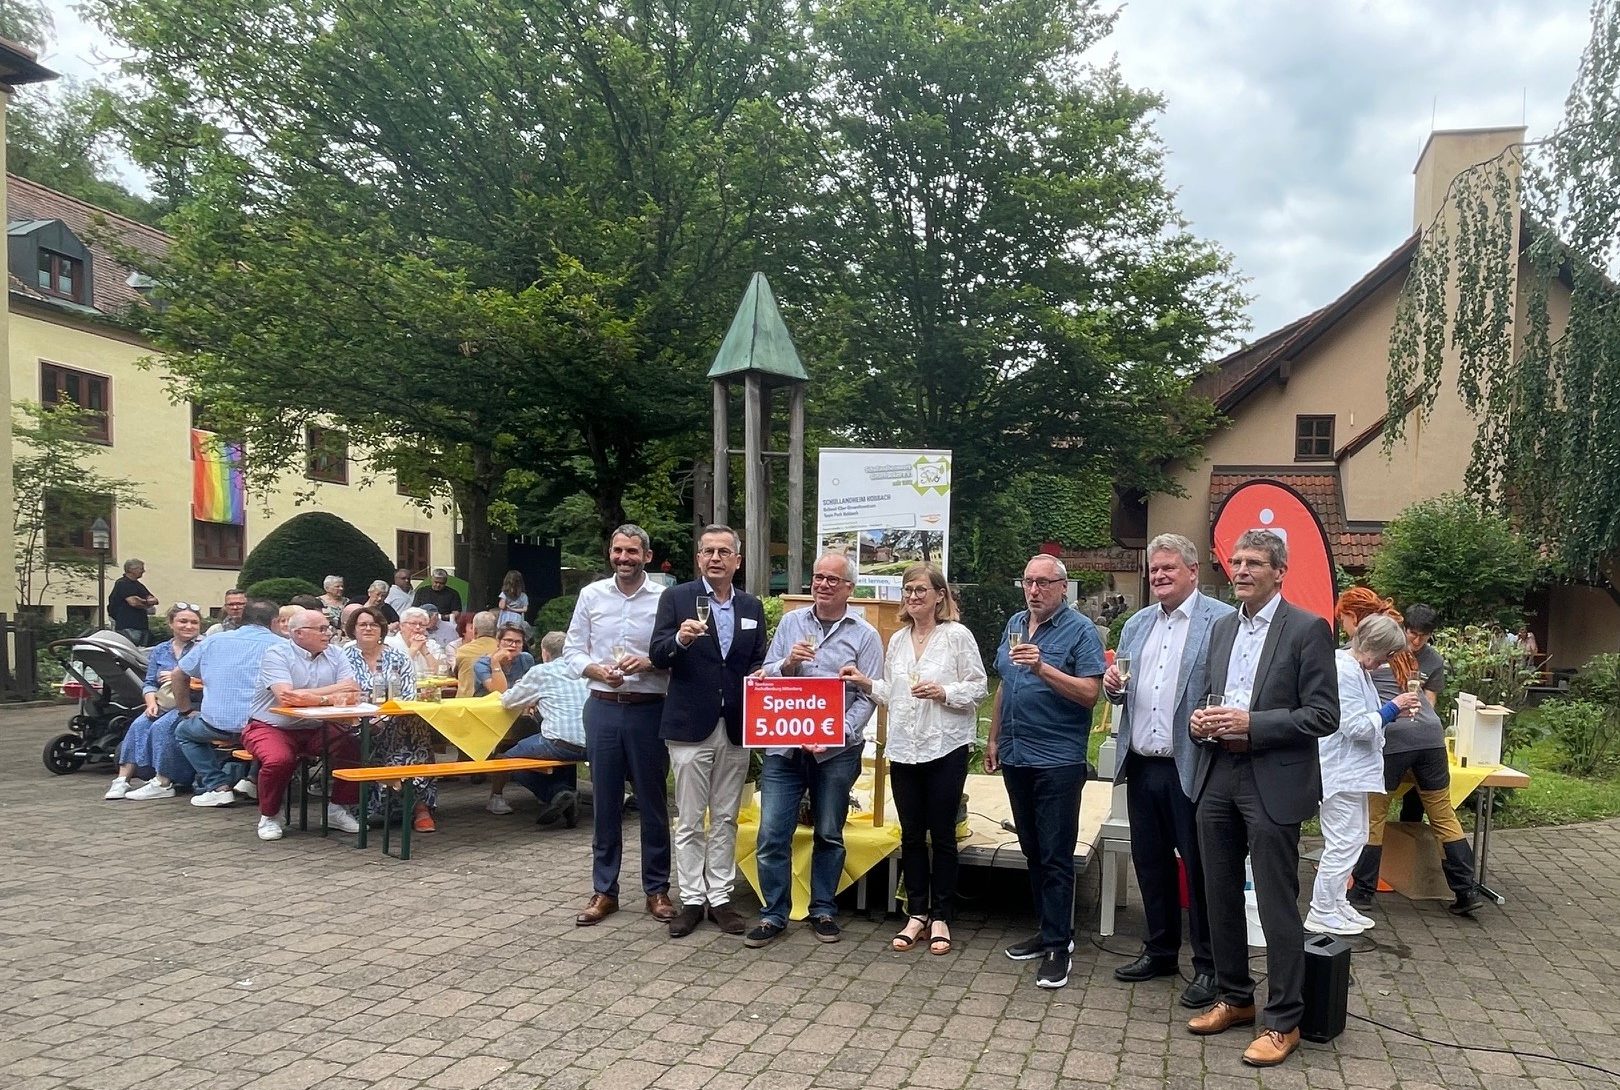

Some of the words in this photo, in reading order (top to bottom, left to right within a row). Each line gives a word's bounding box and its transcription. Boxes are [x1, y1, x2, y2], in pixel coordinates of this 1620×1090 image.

[763, 694, 826, 713] Spende
[755, 718, 815, 736] 5.000
[820, 718, 835, 736] €
